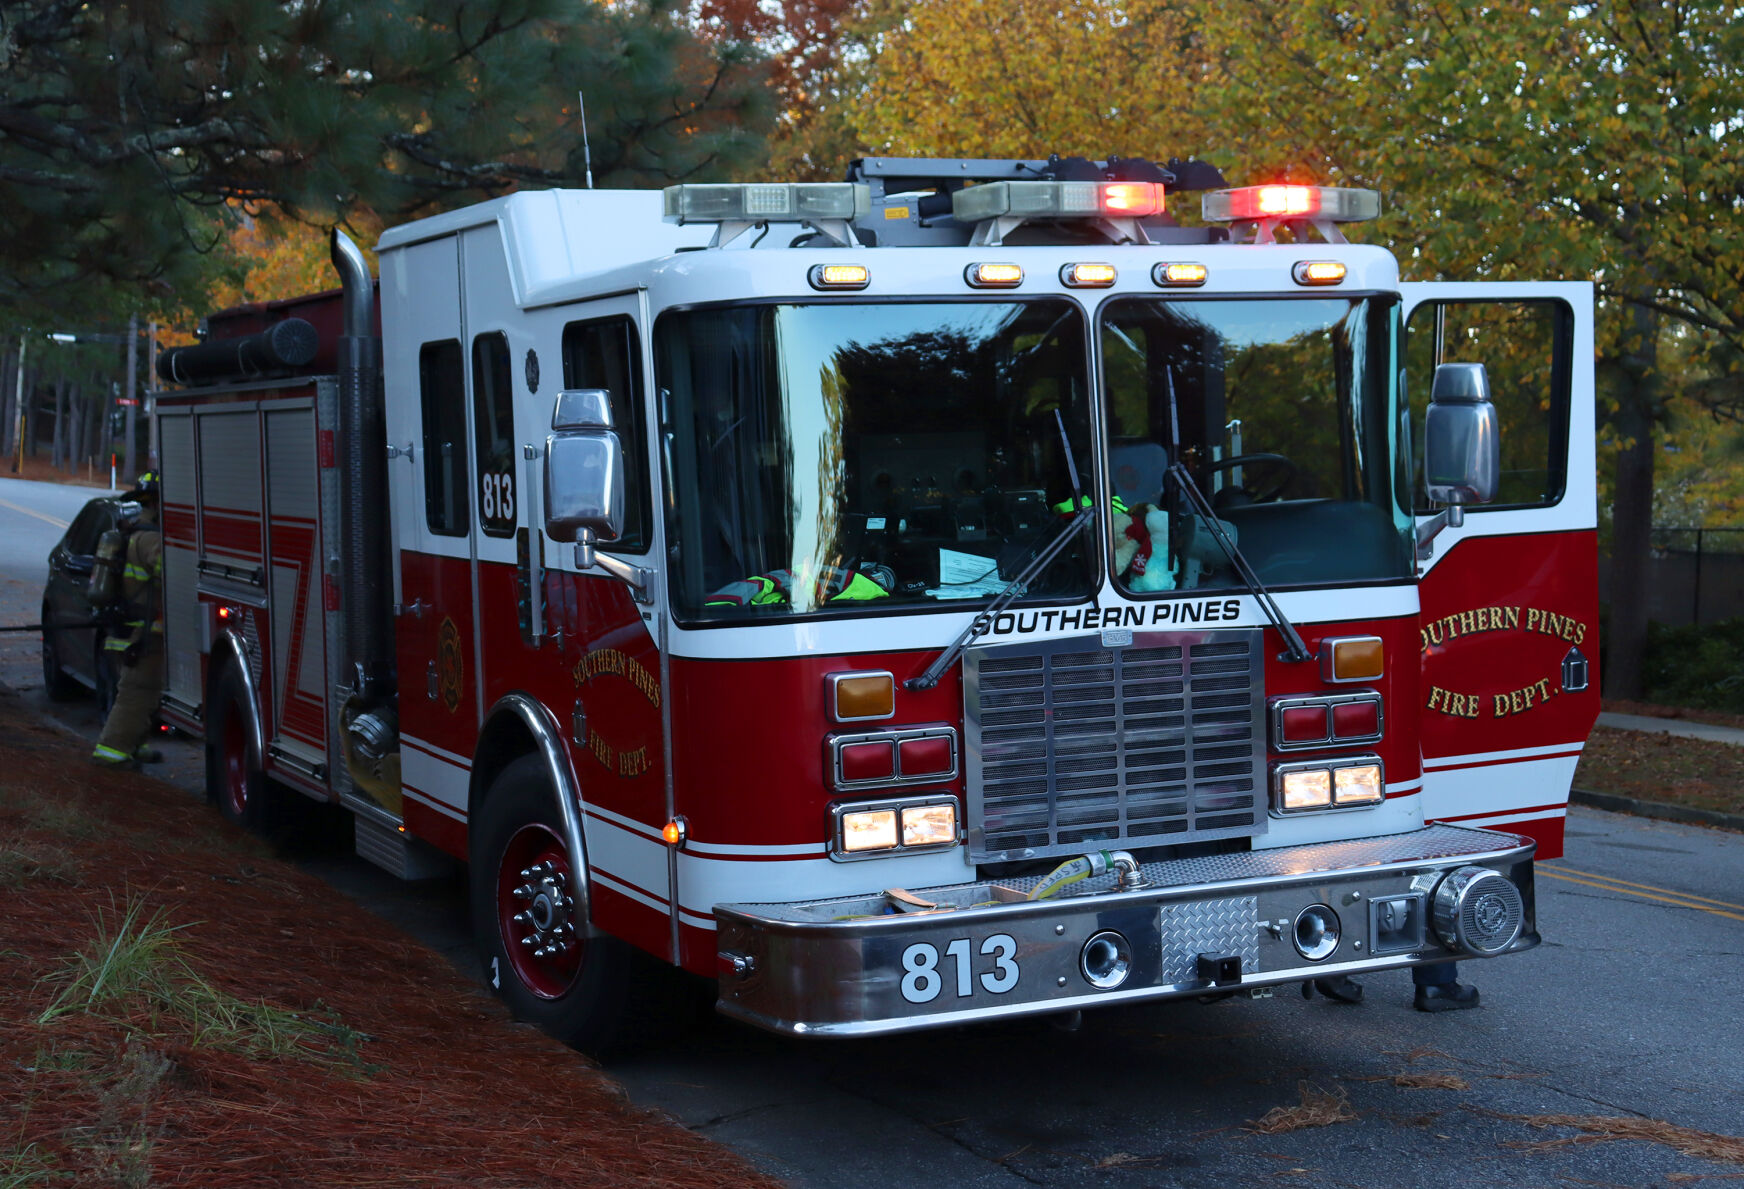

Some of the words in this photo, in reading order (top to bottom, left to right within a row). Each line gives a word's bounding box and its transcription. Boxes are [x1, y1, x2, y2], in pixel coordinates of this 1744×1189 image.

[483, 473, 513, 520] 813
[971, 605, 1145, 636] SOUTHERN
[1152, 599, 1241, 625] PINES
[1420, 606, 1521, 652] OUTHERN
[1526, 607, 1587, 646] PINES
[573, 648, 626, 688] SOUTHERN
[629, 656, 661, 708] PINES
[1427, 685, 1480, 718] FIRE
[1494, 678, 1559, 718] DEPT.
[590, 728, 613, 770] FIRE
[619, 746, 652, 776] DEPT.
[900, 933, 1020, 1004] 813
